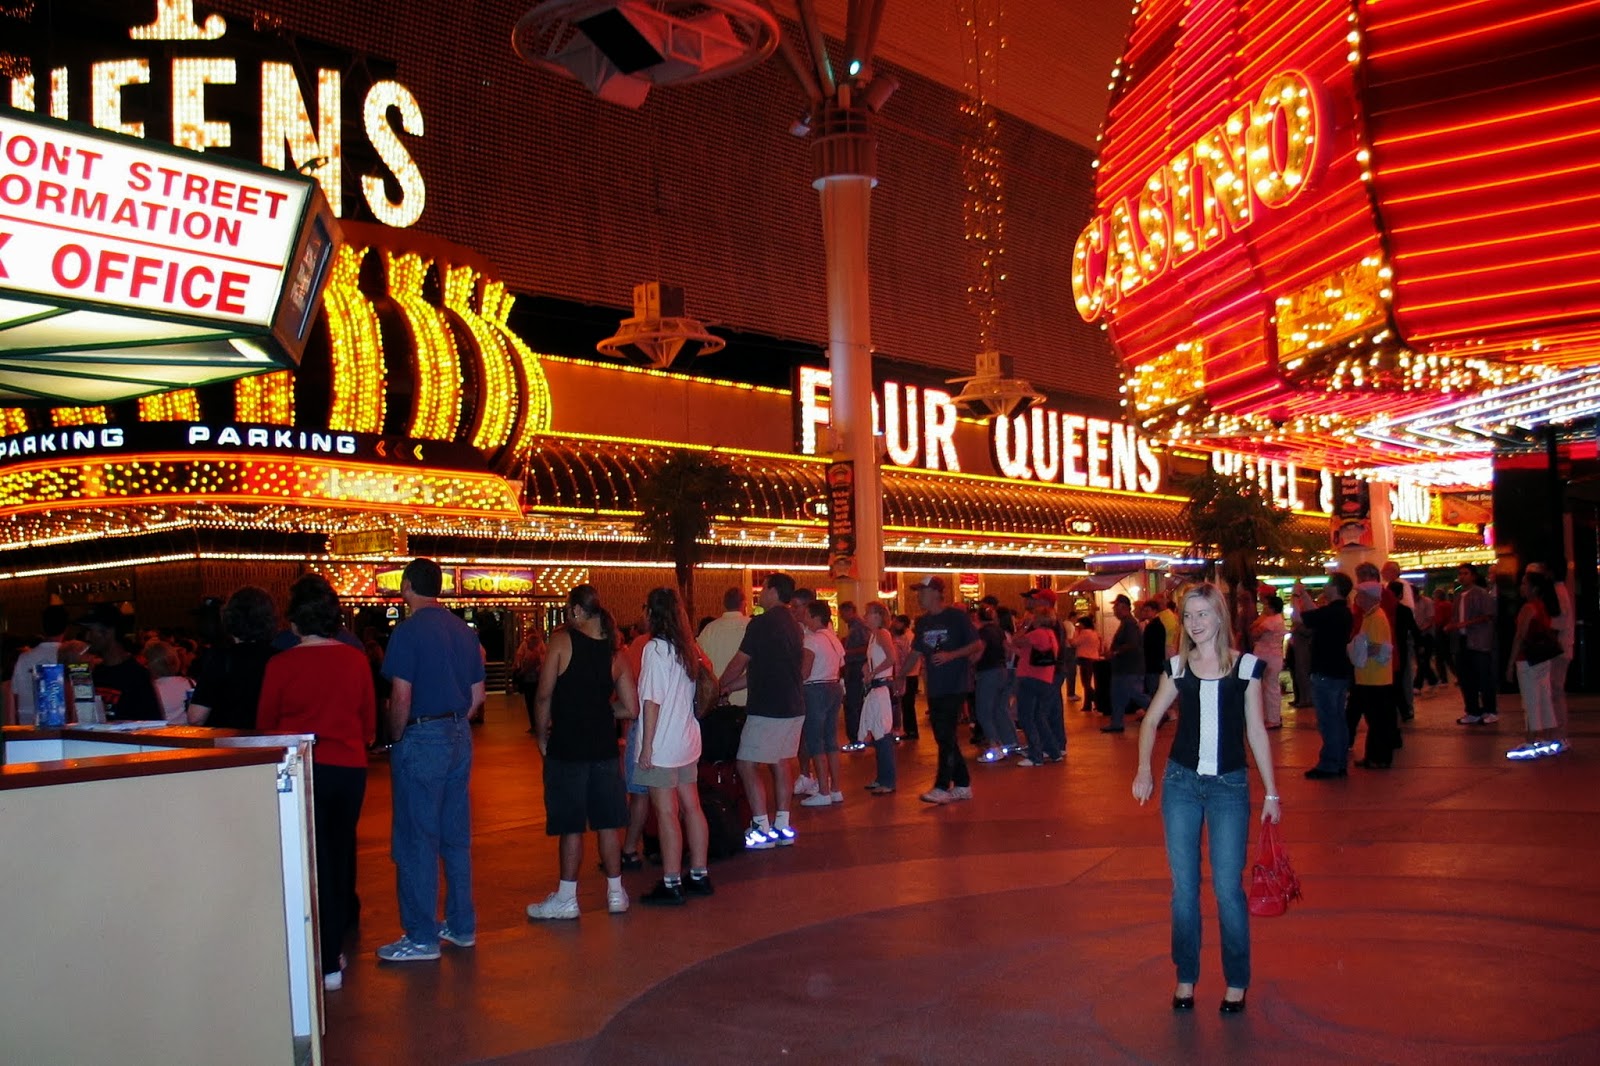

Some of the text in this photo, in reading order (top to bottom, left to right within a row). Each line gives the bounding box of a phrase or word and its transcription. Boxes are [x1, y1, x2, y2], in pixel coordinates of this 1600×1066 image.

[0, 129, 289, 220] ONT STREET
[0, 173, 243, 247] ORMATION
[1071, 69, 1321, 323] CASINO
[51, 243, 252, 316] OFFICE
[188, 426, 357, 455] PARKING
[799, 365, 962, 474] FUR
[995, 407, 1162, 494] QUEENS
